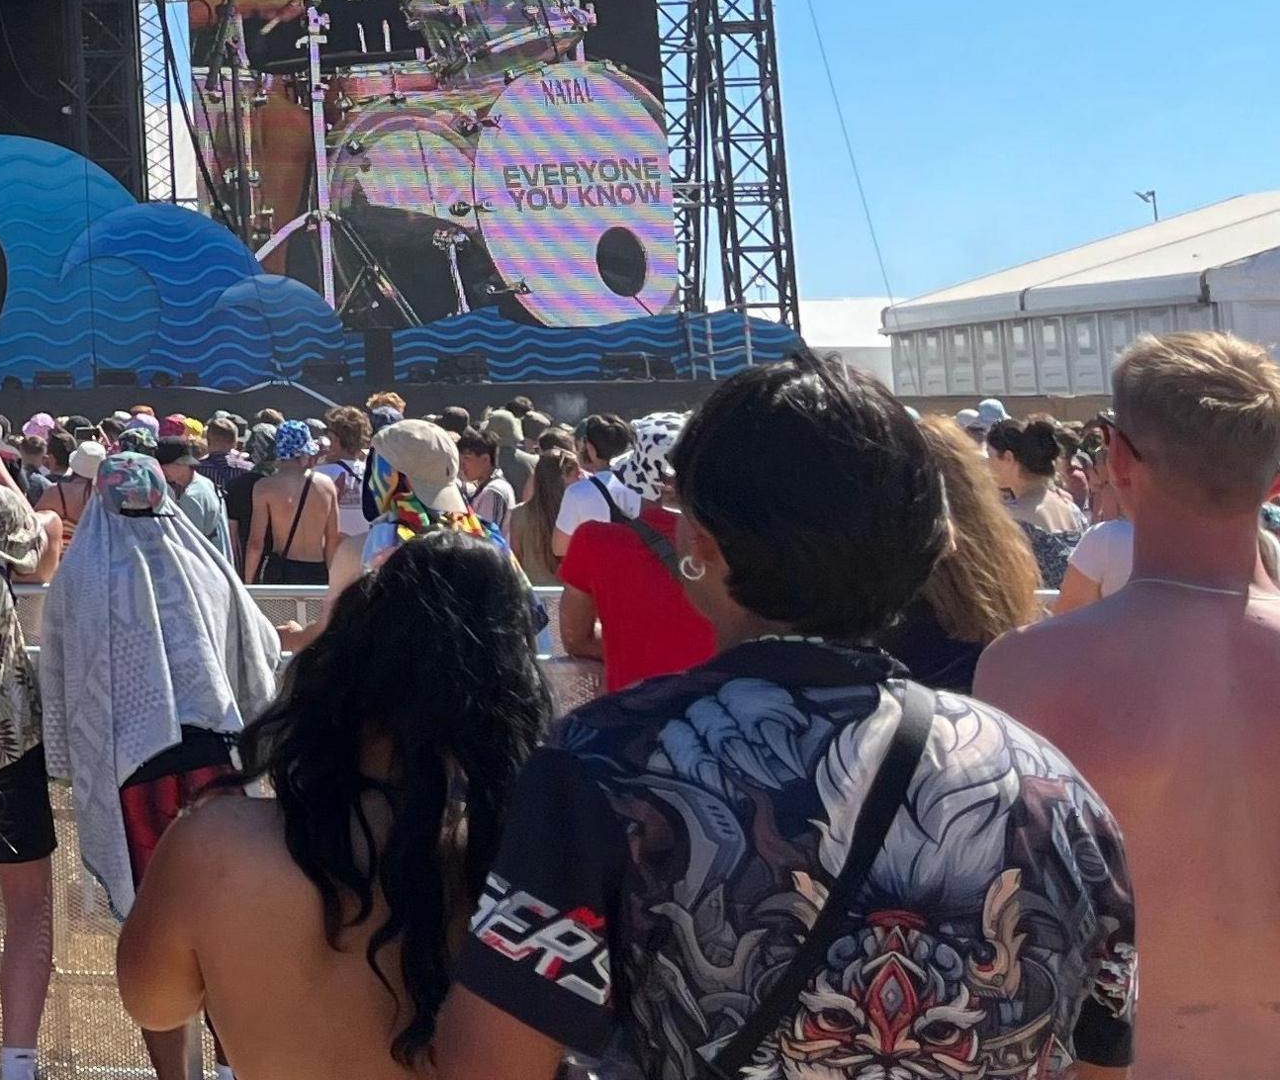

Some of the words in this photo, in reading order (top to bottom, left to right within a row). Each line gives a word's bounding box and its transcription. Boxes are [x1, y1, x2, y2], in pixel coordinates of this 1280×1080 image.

[503, 157, 661, 189] EVERYONE
[508, 186, 569, 212] YOU
[578, 180, 661, 208] KNOW
